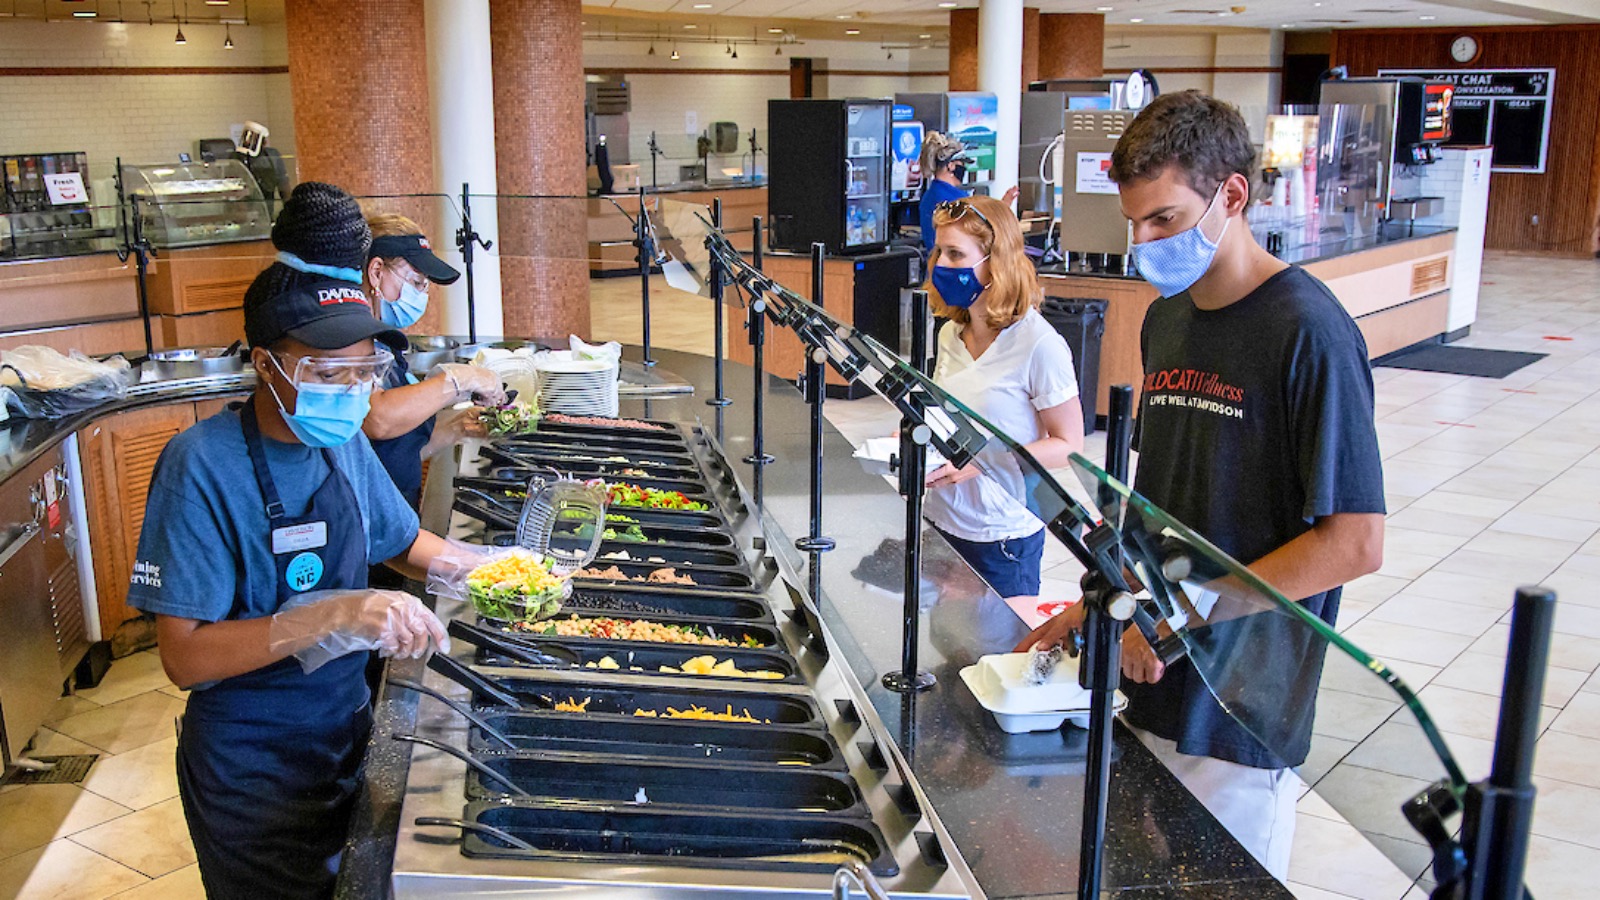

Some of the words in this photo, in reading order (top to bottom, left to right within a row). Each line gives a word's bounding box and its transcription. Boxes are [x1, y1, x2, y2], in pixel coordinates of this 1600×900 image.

[1462, 75, 1493, 84] CHAT
[1150, 395, 1167, 405] LIVE
[1168, 395, 1187, 406] WELL
[131, 573, 162, 588] ervices
[296, 572, 316, 587] NC
